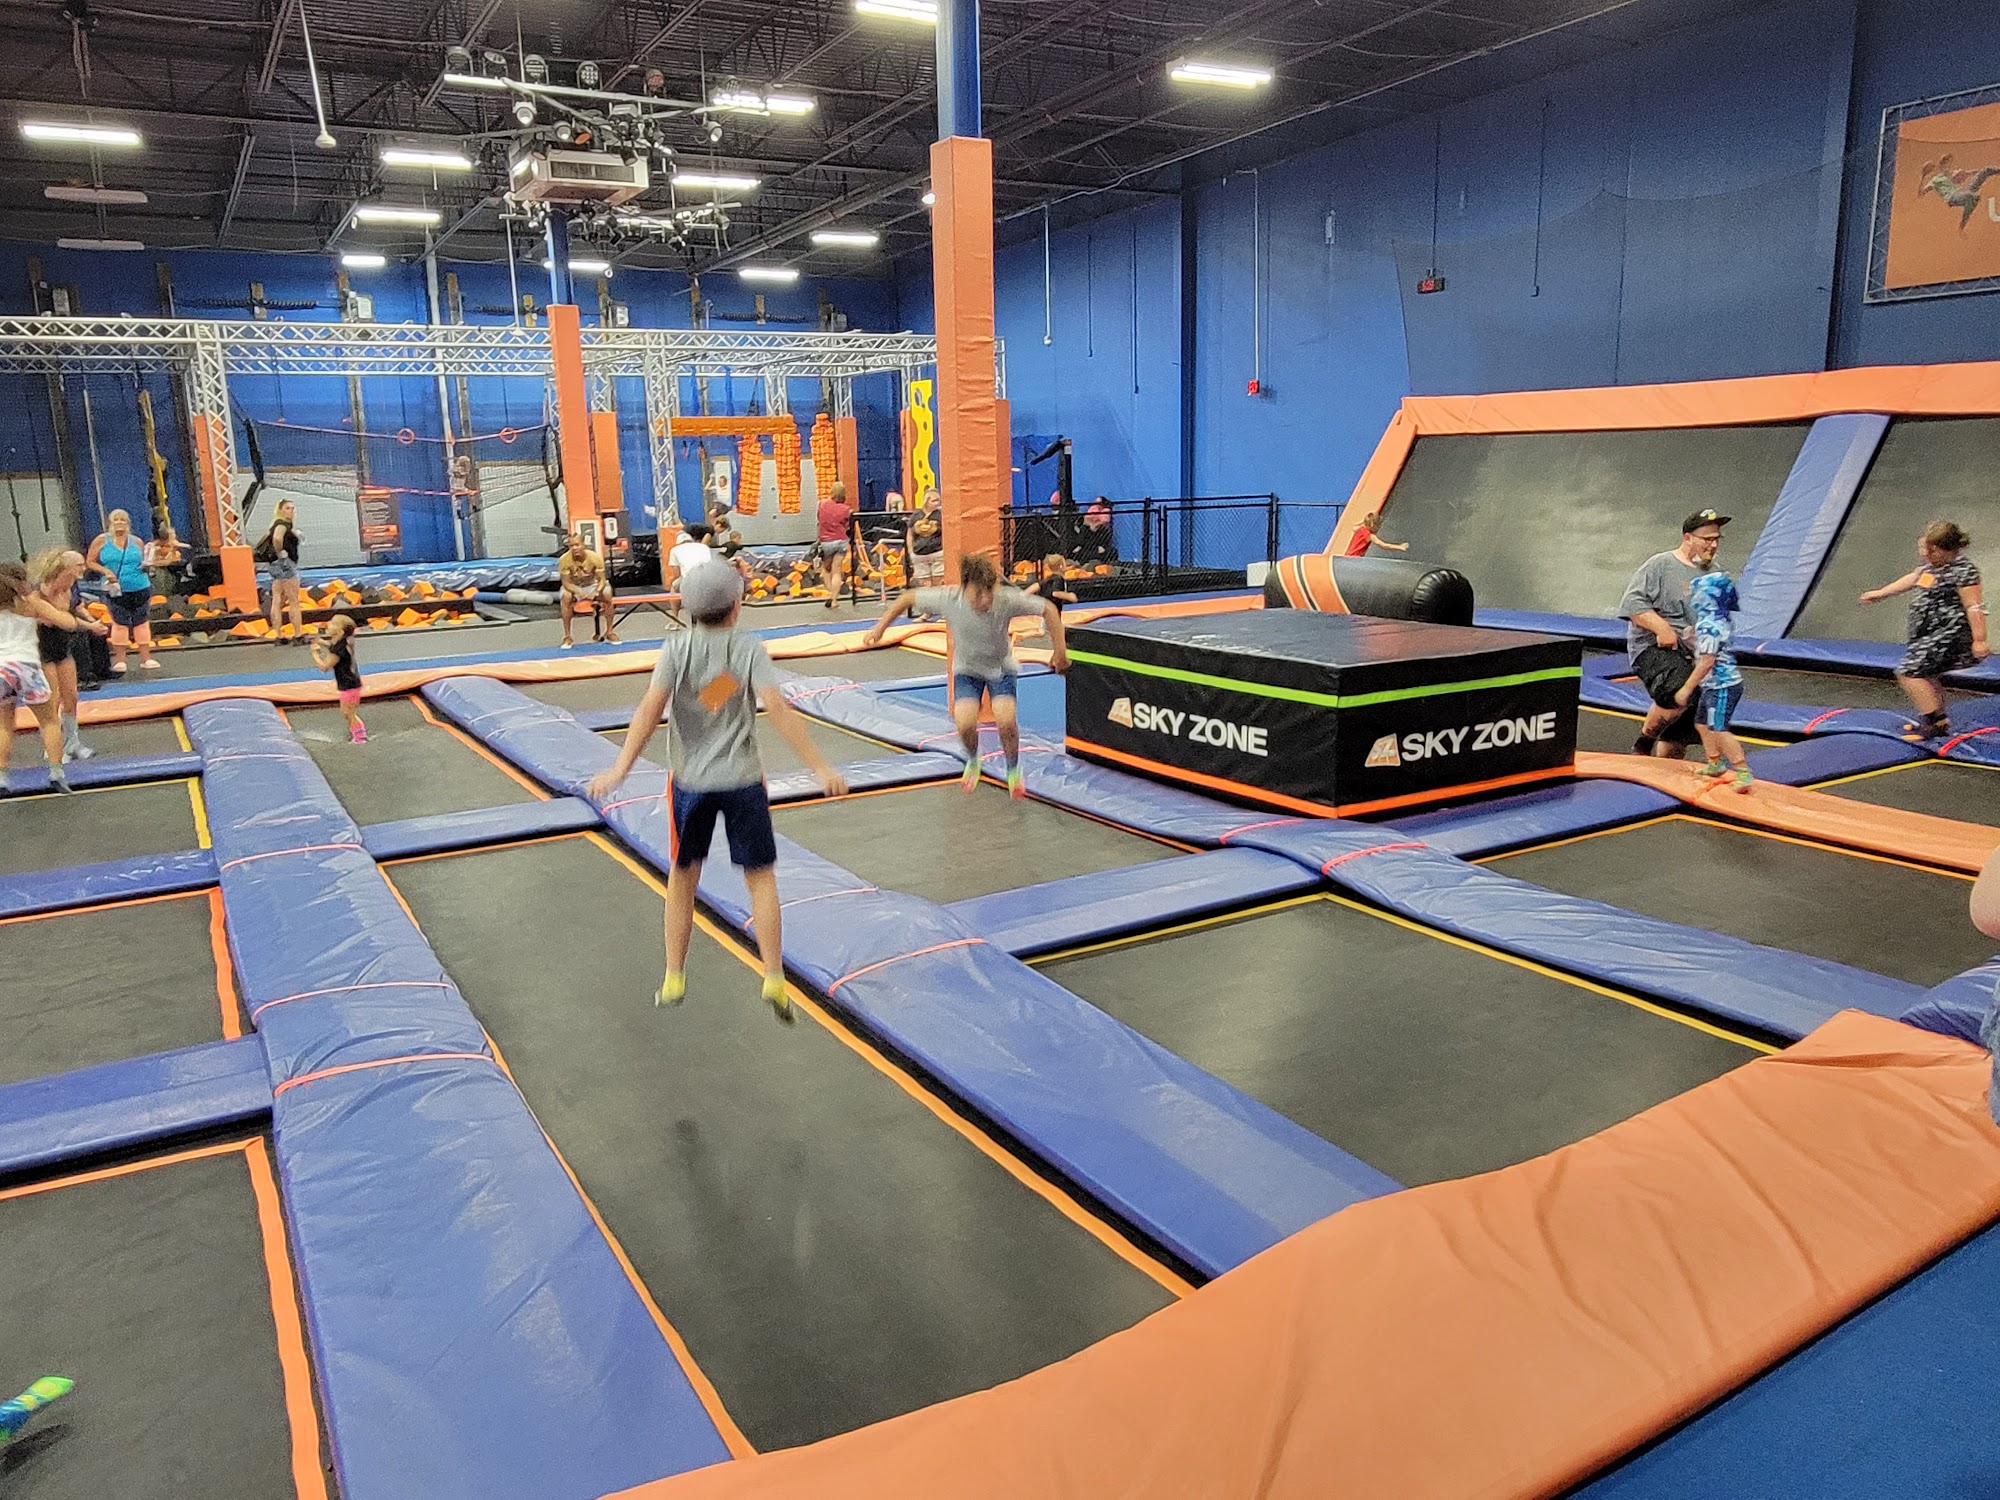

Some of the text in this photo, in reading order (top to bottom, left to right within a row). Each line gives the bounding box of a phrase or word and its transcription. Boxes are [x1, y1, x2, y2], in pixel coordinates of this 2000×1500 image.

[1133, 702, 1186, 736] SKY
[1188, 714, 1269, 757] ZONE
[1401, 726, 1470, 761] SKY
[1471, 711, 1557, 751] ZONE
